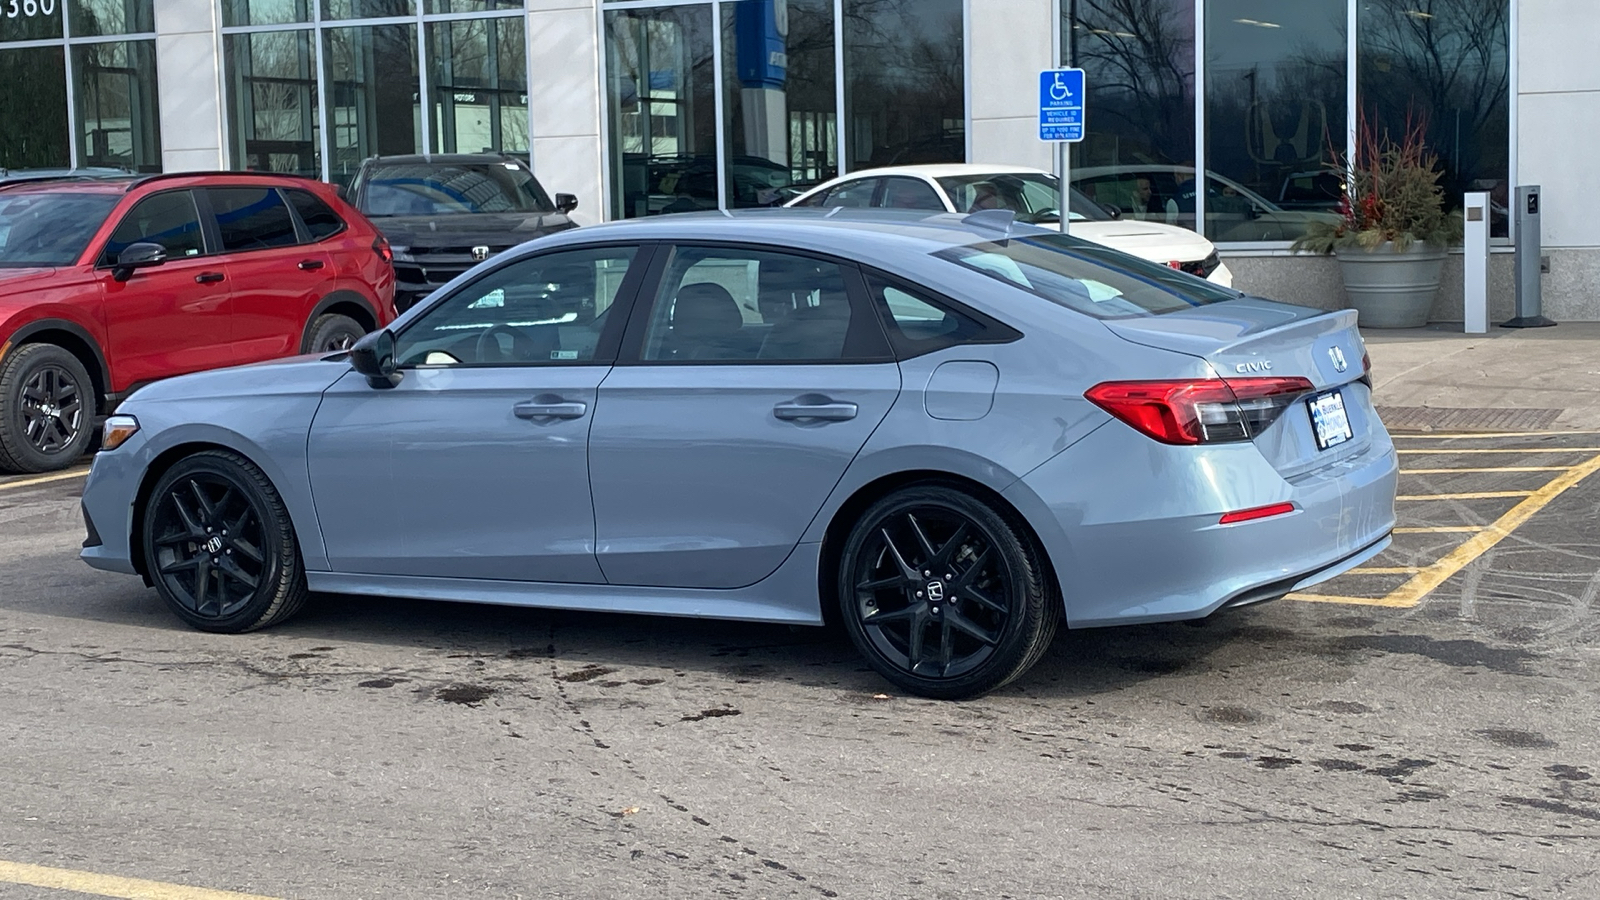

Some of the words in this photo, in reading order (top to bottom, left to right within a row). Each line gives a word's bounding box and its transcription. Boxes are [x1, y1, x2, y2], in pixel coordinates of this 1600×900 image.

[0, 0, 55, 18] 360
[1236, 360, 1273, 374] CIVIC
[1321, 401, 1343, 415] BUERKLE
[1324, 413, 1348, 432] HONDA
